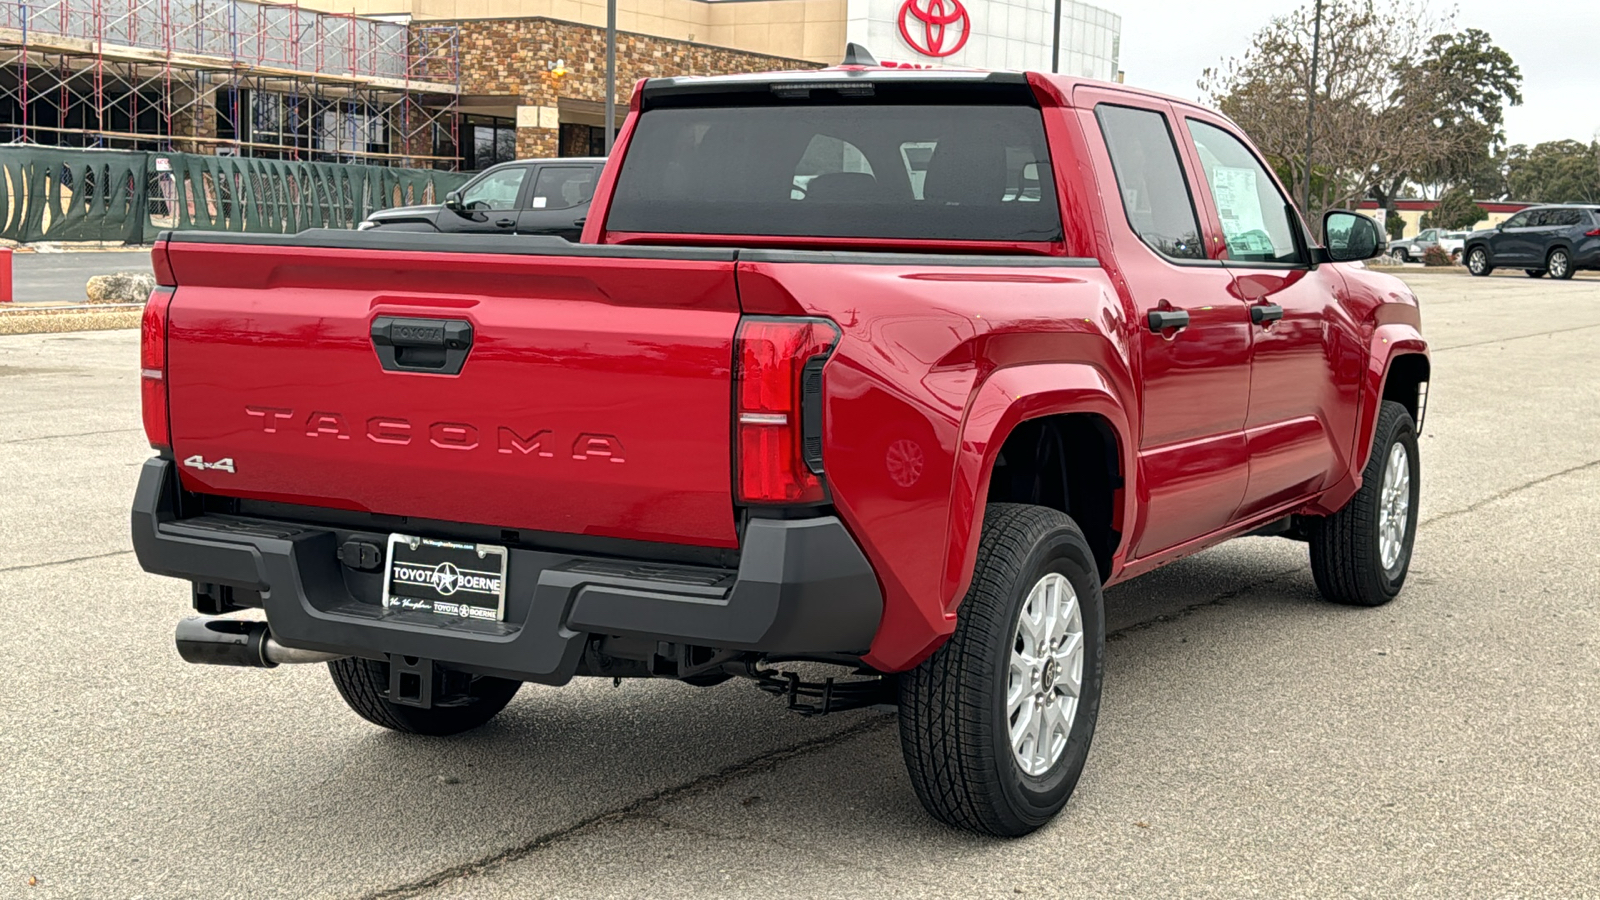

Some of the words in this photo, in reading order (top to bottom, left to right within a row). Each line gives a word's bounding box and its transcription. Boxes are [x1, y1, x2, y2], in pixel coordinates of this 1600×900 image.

[393, 327, 441, 339] TOYOTA
[245, 405, 625, 463] TACOMA
[394, 567, 439, 583] TOYOTA
[458, 575, 500, 590] BOERNE
[434, 604, 458, 613] TOYOTA
[470, 610, 496, 618] BOERNE
